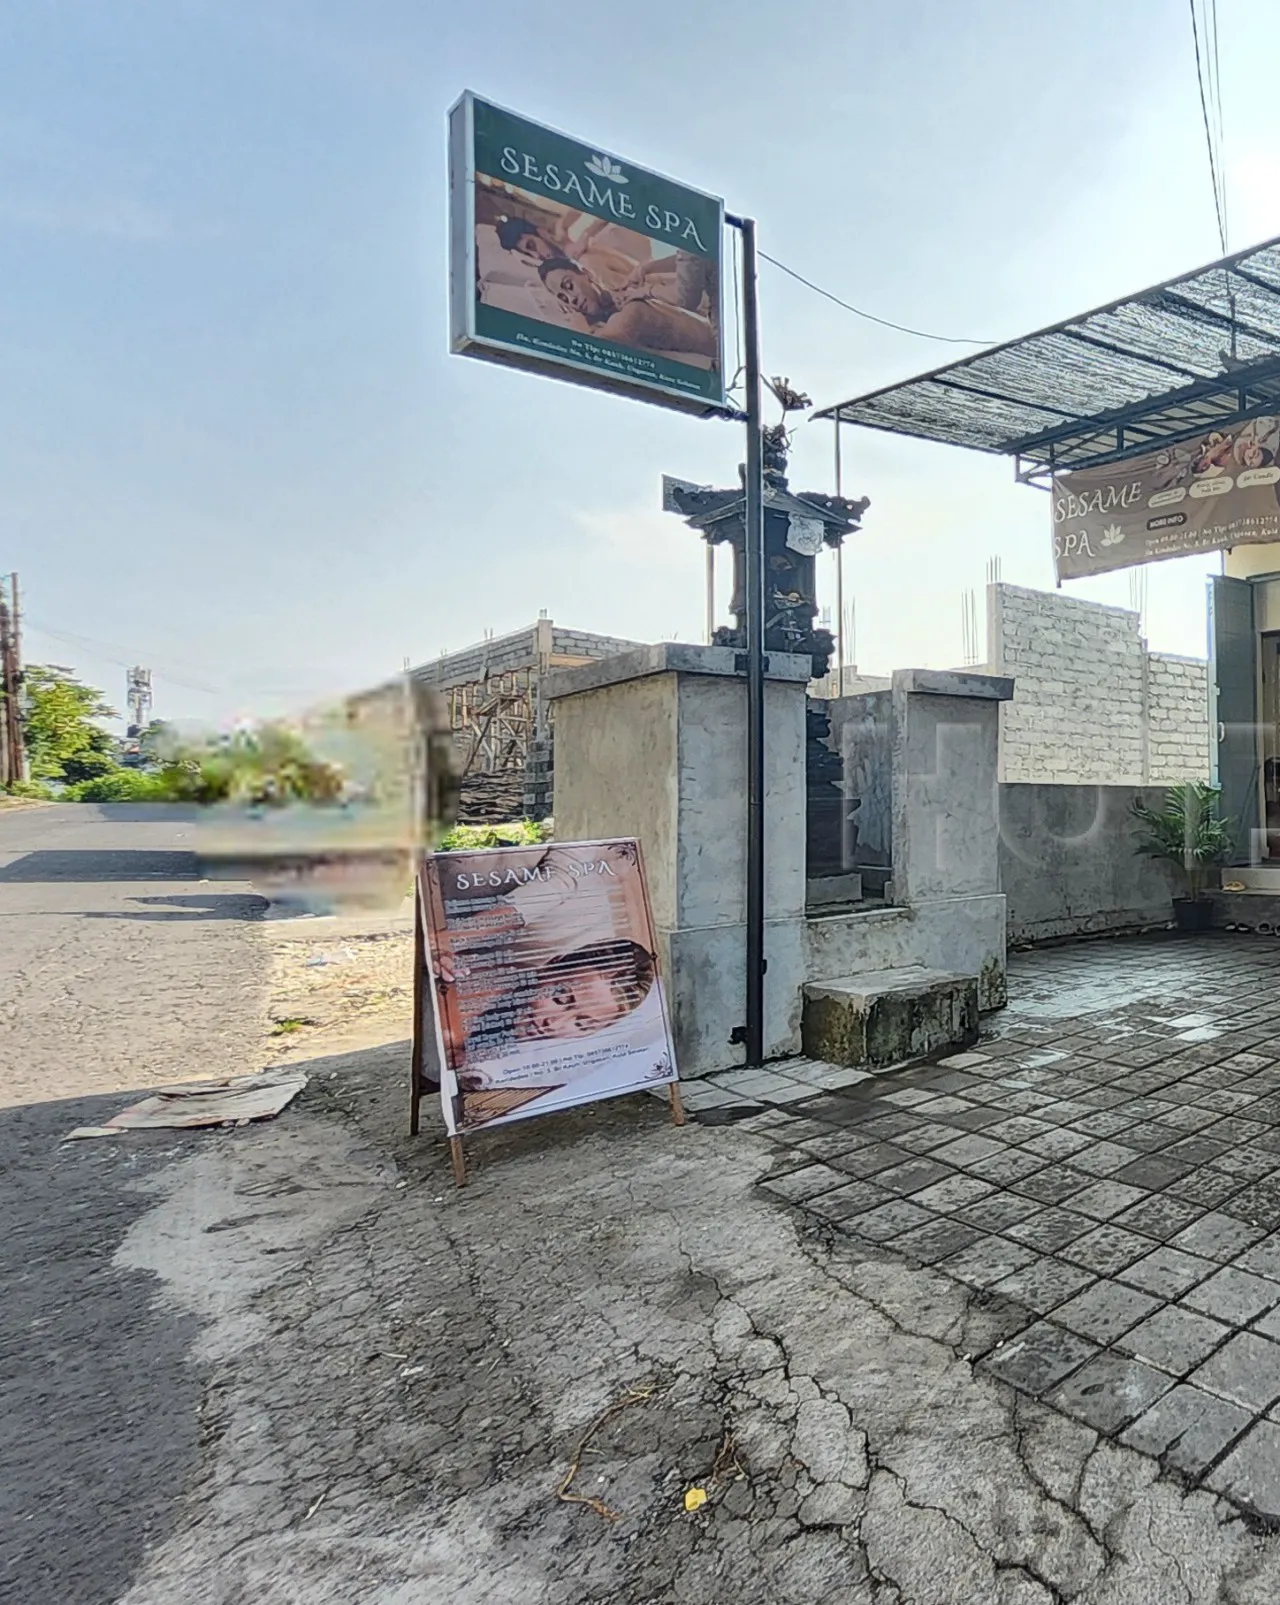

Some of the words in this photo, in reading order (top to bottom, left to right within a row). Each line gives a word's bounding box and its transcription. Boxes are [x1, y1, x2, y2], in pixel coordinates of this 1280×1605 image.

[500, 146, 636, 218] SESAME
[646, 204, 708, 252] SPA
[1054, 481, 1141, 523] SESAME
[1149, 517, 1166, 528] MORE
[1167, 515, 1183, 525] INFO
[1054, 530, 1095, 559] SPA
[457, 866, 557, 890] SESAME
[568, 859, 616, 879] SPA
